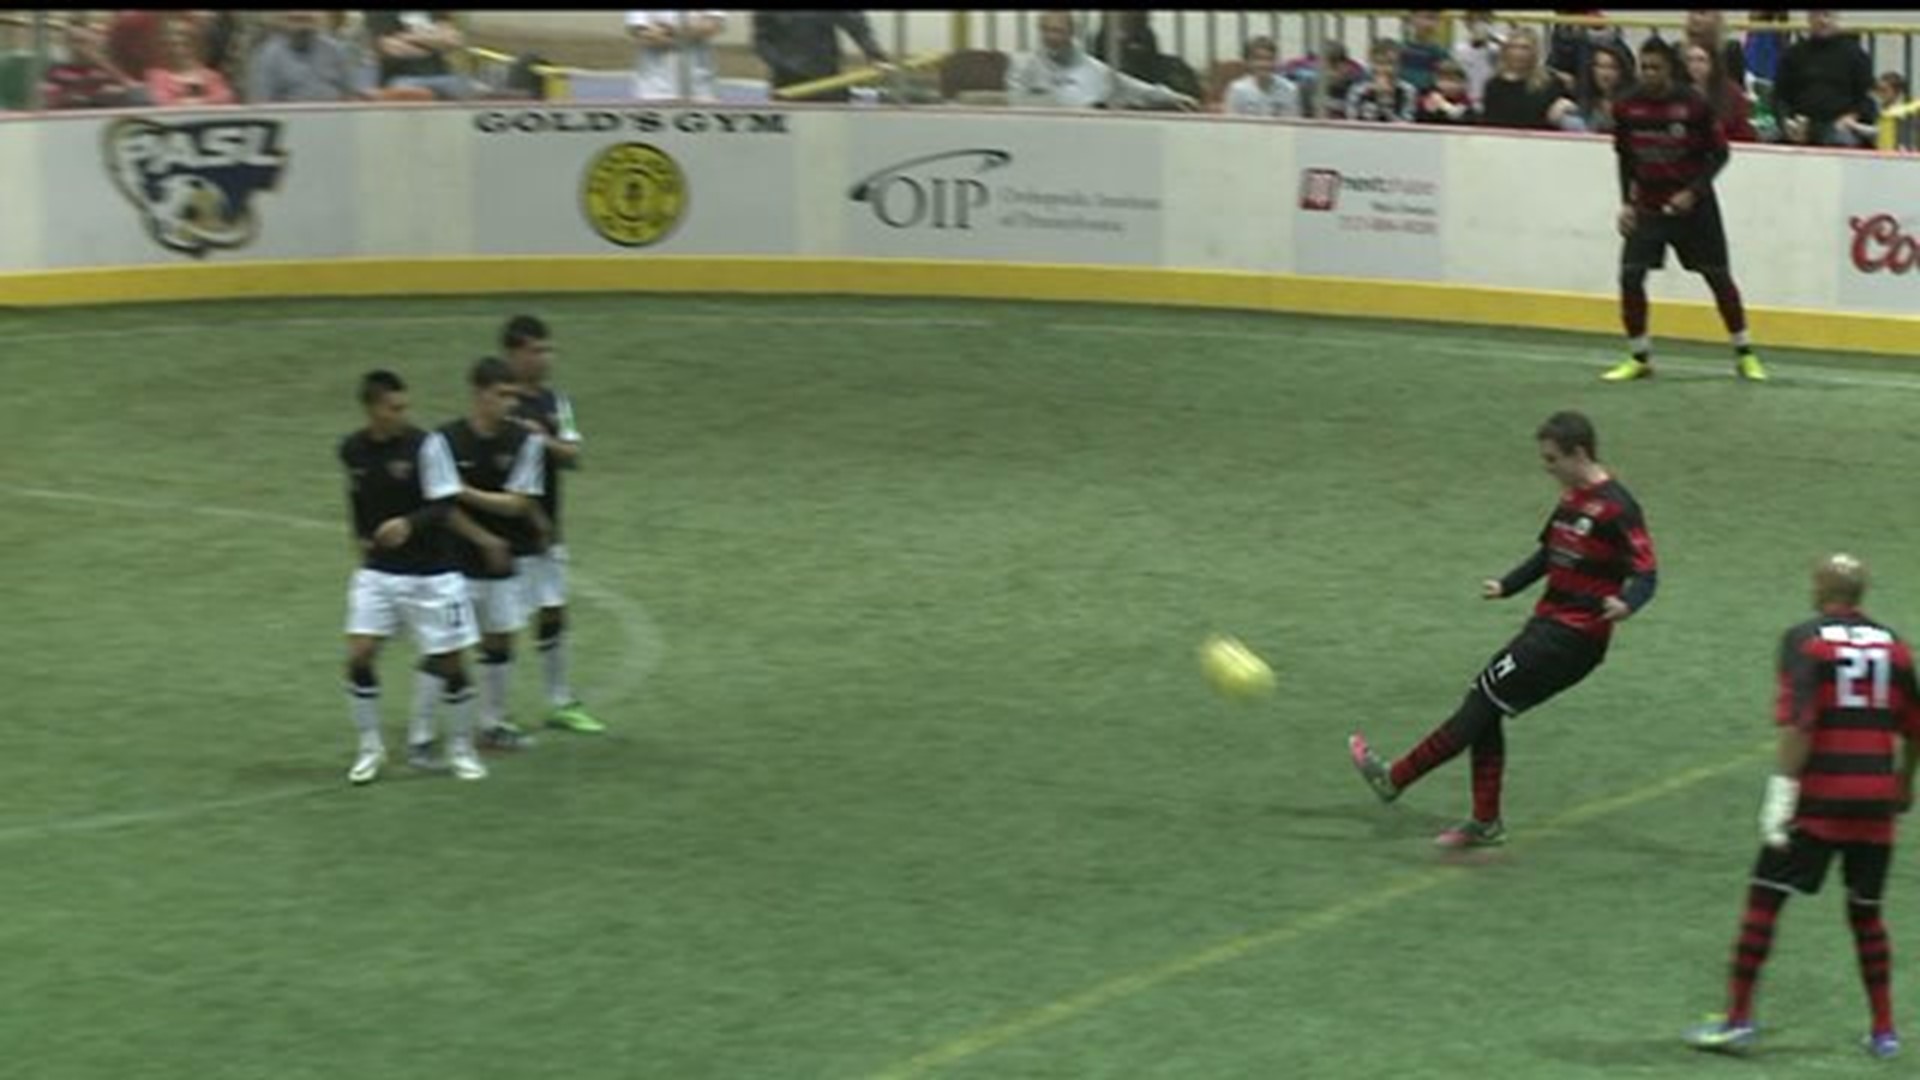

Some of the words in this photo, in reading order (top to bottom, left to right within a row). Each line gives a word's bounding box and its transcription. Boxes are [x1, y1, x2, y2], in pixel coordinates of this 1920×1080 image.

[474, 110, 666, 133] GOLD'S
[674, 110, 790, 134] GYM
[870, 175, 990, 230] OIP
[1848, 212, 1920, 276] Co
[1835, 646, 1892, 709] 27
